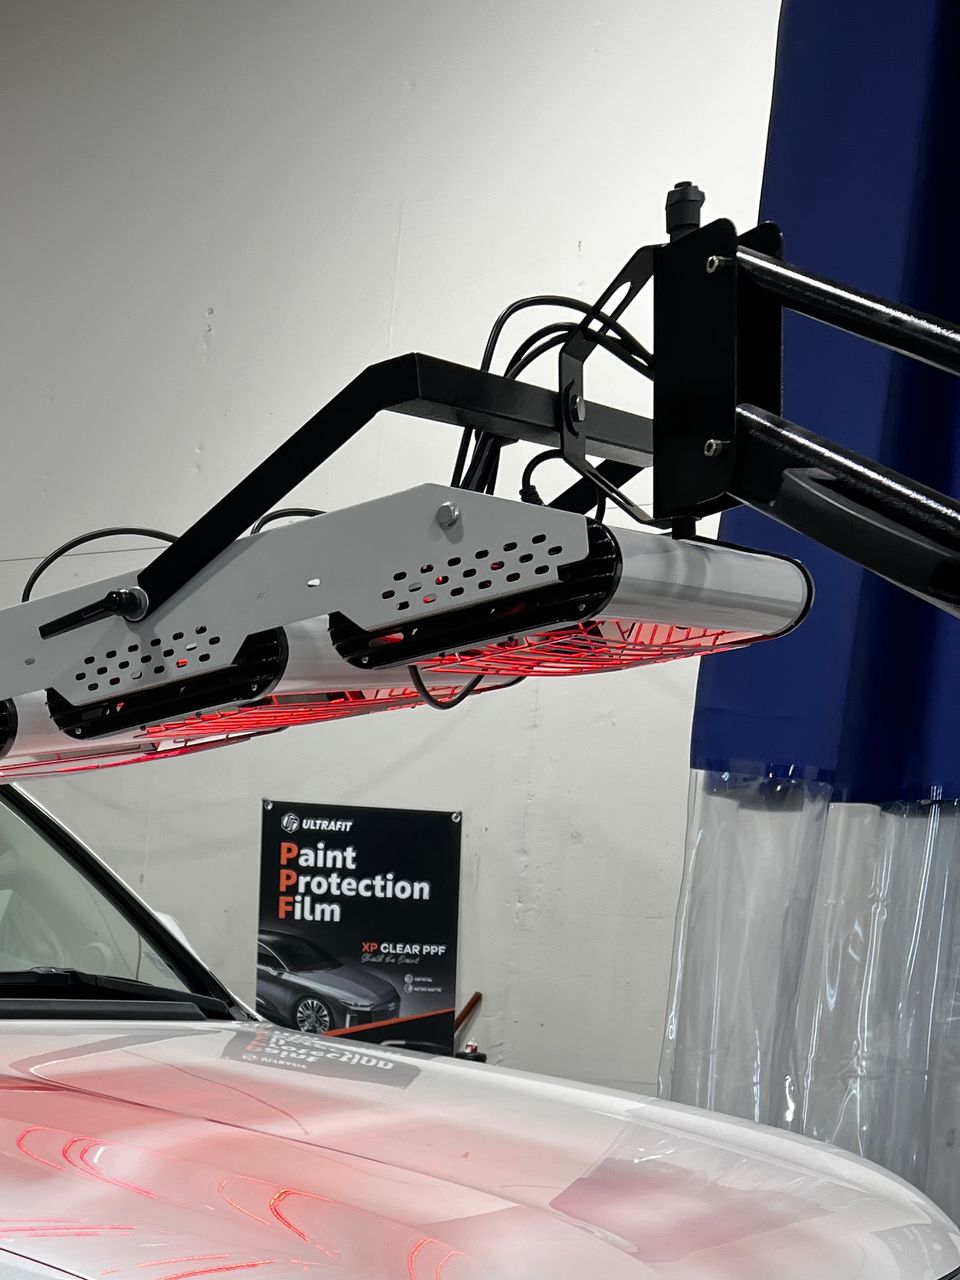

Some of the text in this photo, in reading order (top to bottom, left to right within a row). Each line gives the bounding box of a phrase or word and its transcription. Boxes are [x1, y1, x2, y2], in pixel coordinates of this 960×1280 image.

[302, 819, 353, 832] ULTRAFIT
[280, 842, 357, 869] Paint
[279, 869, 430, 900] Protection
[278, 896, 341, 922] Film
[361, 942, 446, 956] XP CLEAR PPF
